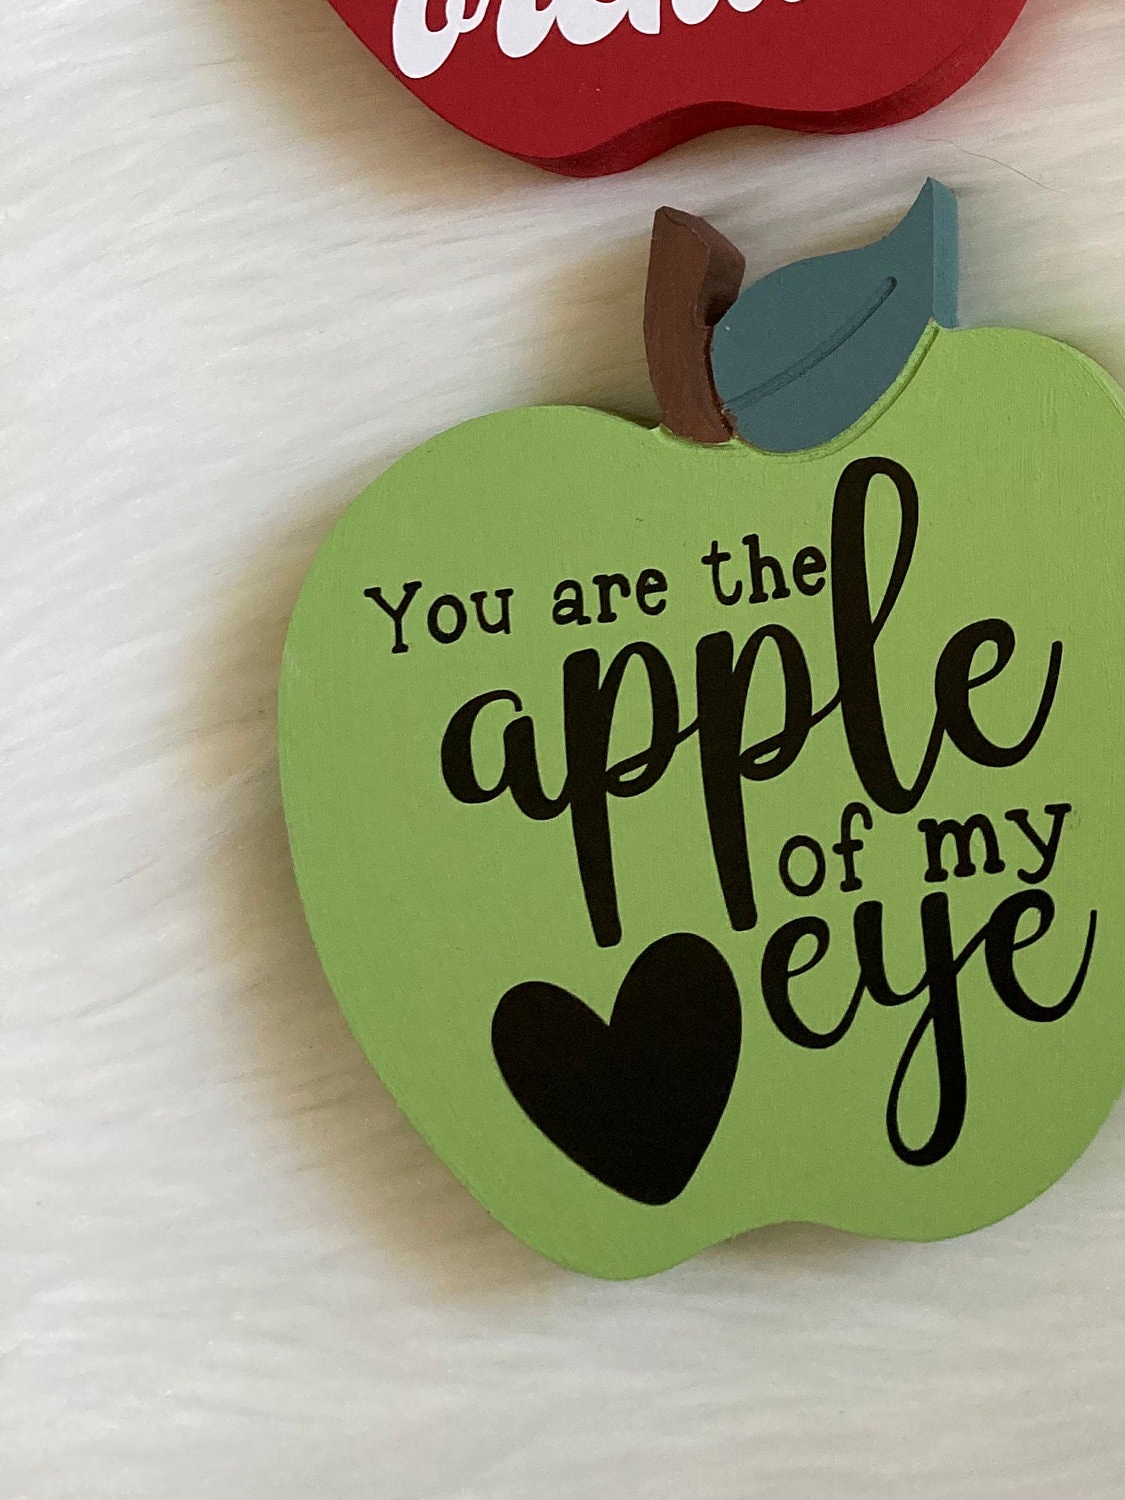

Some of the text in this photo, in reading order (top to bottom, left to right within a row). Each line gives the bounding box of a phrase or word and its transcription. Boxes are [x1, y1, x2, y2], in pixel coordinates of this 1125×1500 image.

[364, 534, 827, 654] You are the
[441, 457, 1062, 948] apple
[779, 802, 1072, 896] of my
[761, 889, 1097, 1166] eye
